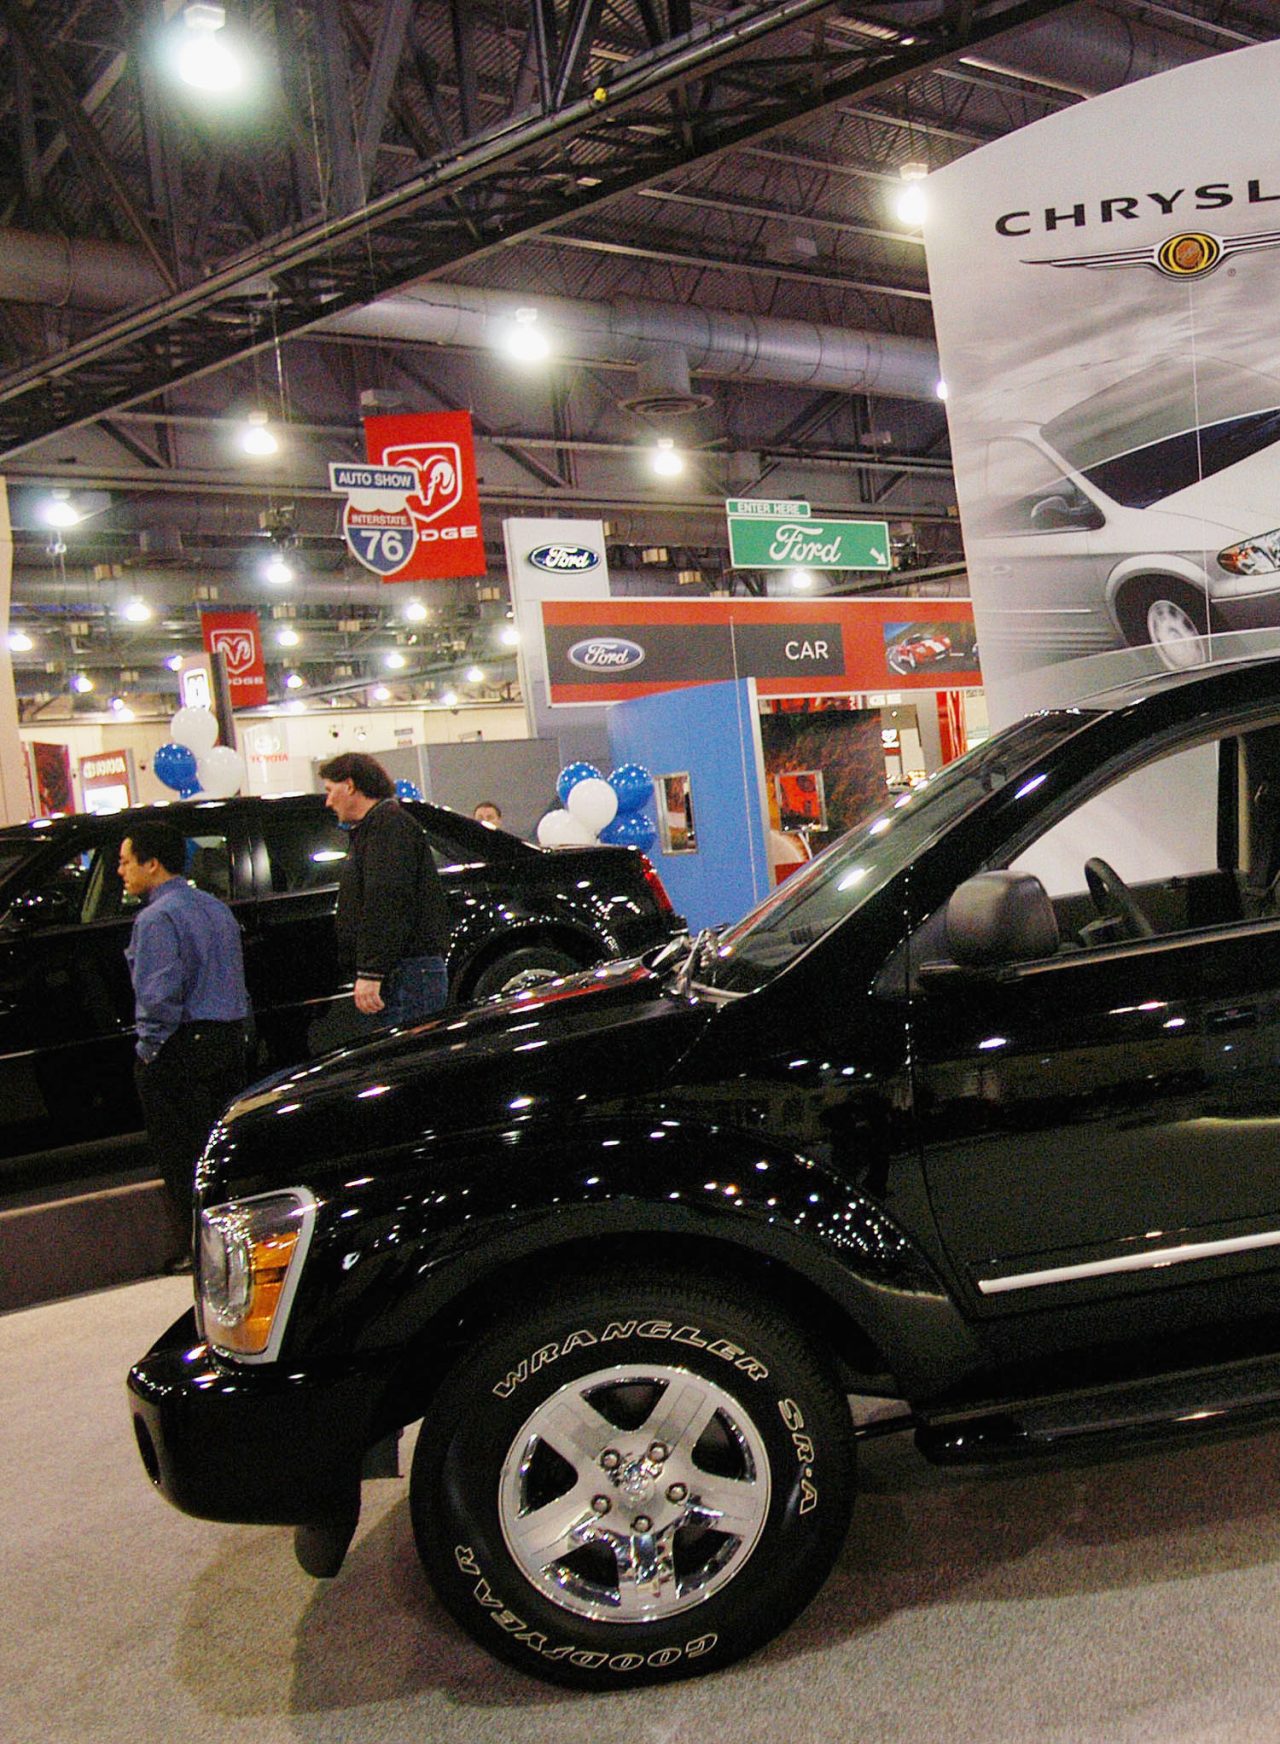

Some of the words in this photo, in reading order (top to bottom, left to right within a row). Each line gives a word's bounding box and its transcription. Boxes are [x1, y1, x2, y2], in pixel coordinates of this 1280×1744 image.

[338, 471, 373, 485] AUTO
[374, 473, 412, 487] SHOW
[737, 502, 770, 513] ENTER
[774, 503, 800, 514] HERE
[351, 514, 407, 525] INTERSTATE
[360, 530, 404, 561] 76
[769, 524, 842, 562] Ford
[545, 546, 591, 568] Ford
[584, 643, 629, 665] Ford
[785, 640, 829, 660] CAR
[493, 1320, 769, 1398] WRANGLER
[455, 1545, 718, 1671] GOODYEAR
